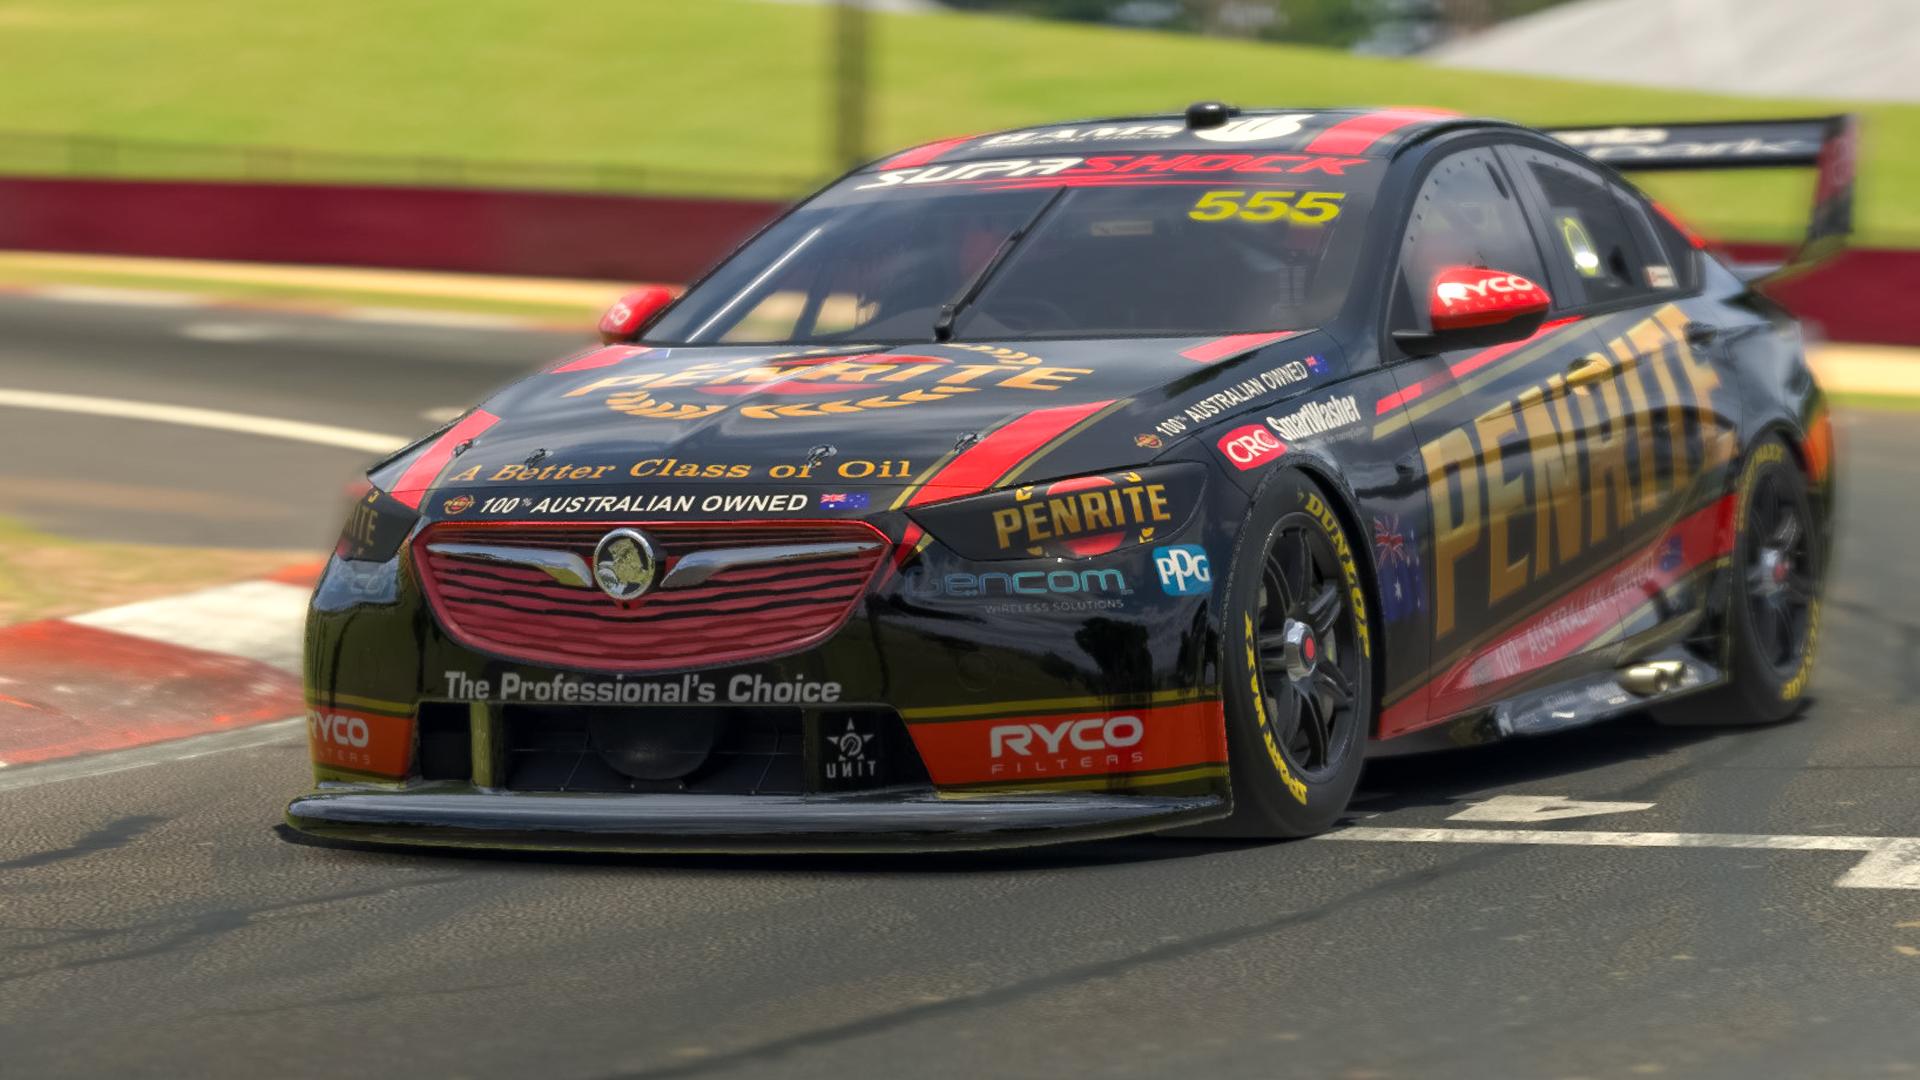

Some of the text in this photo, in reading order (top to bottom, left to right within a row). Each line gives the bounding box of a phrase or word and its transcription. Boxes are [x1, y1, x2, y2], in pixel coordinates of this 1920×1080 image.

[854, 154, 1369, 191] SUPASHOCK
[1188, 190, 1346, 225] 555
[1437, 274, 1534, 308] RYCO
[563, 362, 1096, 398] PENRITE
[1184, 377, 1267, 424] AUSTRALIAN
[1260, 360, 1309, 390] OWNED
[1266, 394, 1362, 442] SmartWasher
[1226, 429, 1280, 463] CRC
[448, 465, 478, 481] A
[487, 462, 617, 481] Better
[630, 459, 740, 479] Class
[837, 460, 913, 479] Oil
[1420, 303, 1740, 641] PENRITE
[480, 497, 533, 514] 100%
[530, 496, 697, 514] AUSTRALIAN
[701, 494, 809, 512] OWNED
[992, 484, 1172, 550] PENRITE
[1156, 549, 1211, 591] PPG
[1304, 491, 1371, 658] DUNLOP
[1053, 600, 1125, 612] SOLUTIONS
[444, 671, 842, 703] The Professional's Choice
[989, 715, 1145, 758] RYCO
[826, 759, 878, 780] UNIT
[991, 751, 1144, 775] FILTERS
